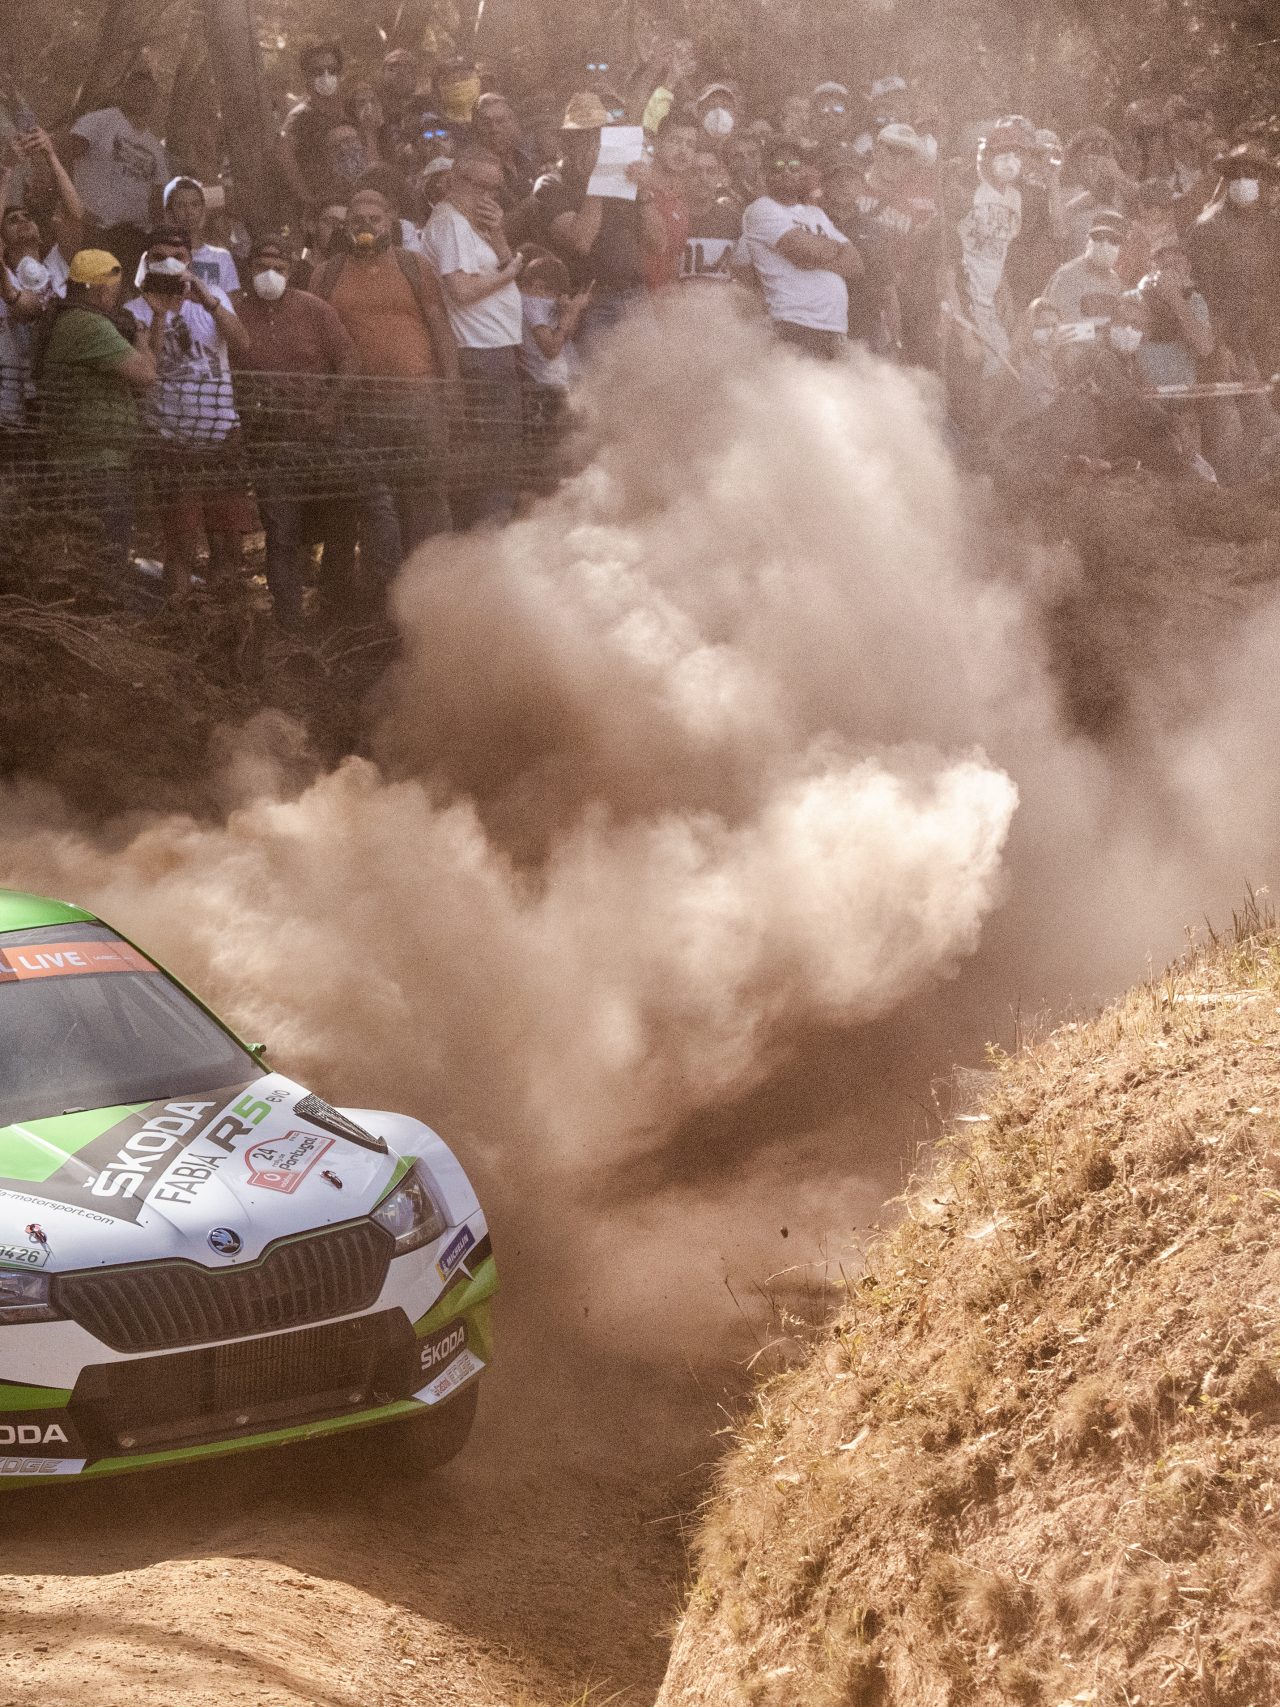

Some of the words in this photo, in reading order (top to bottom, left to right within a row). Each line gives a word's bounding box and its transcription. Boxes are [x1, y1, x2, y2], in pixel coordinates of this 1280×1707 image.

[18, 951, 86, 970] LIVE
[82, 1101, 216, 1198] ŠKODA
[154, 1153, 227, 1204] FABIA
[205, 1094, 272, 1153] R5
[264, 1089, 291, 1103] evo
[252, 1148, 278, 1161] 24
[279, 1137, 318, 1171] Portugal
[446, 1233, 469, 1267] MICHELIN
[421, 1326, 465, 1370] ŠKODA
